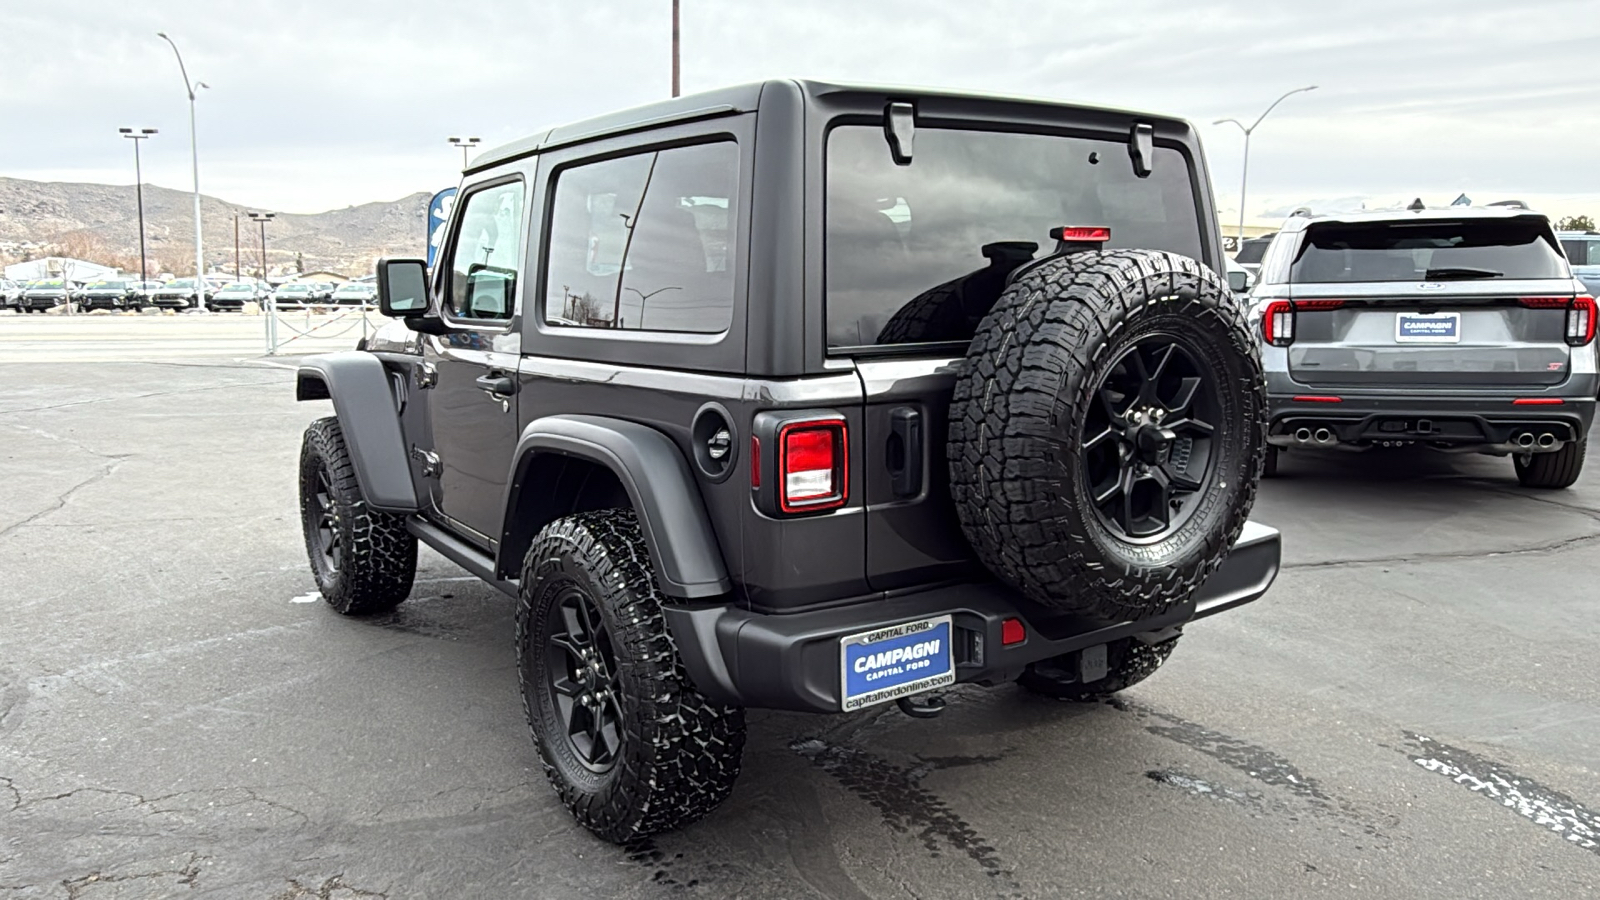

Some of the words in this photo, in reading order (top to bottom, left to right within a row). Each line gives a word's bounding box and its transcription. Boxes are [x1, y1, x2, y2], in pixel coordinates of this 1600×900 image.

[867, 629, 903, 642] CAPITAL
[905, 621, 929, 634] FORD
[854, 639, 940, 673] CAMPAGNI
[866, 666, 904, 681] CAPITAL
[906, 660, 930, 672] FORD
[846, 675, 953, 709] capitalfordonline.com
